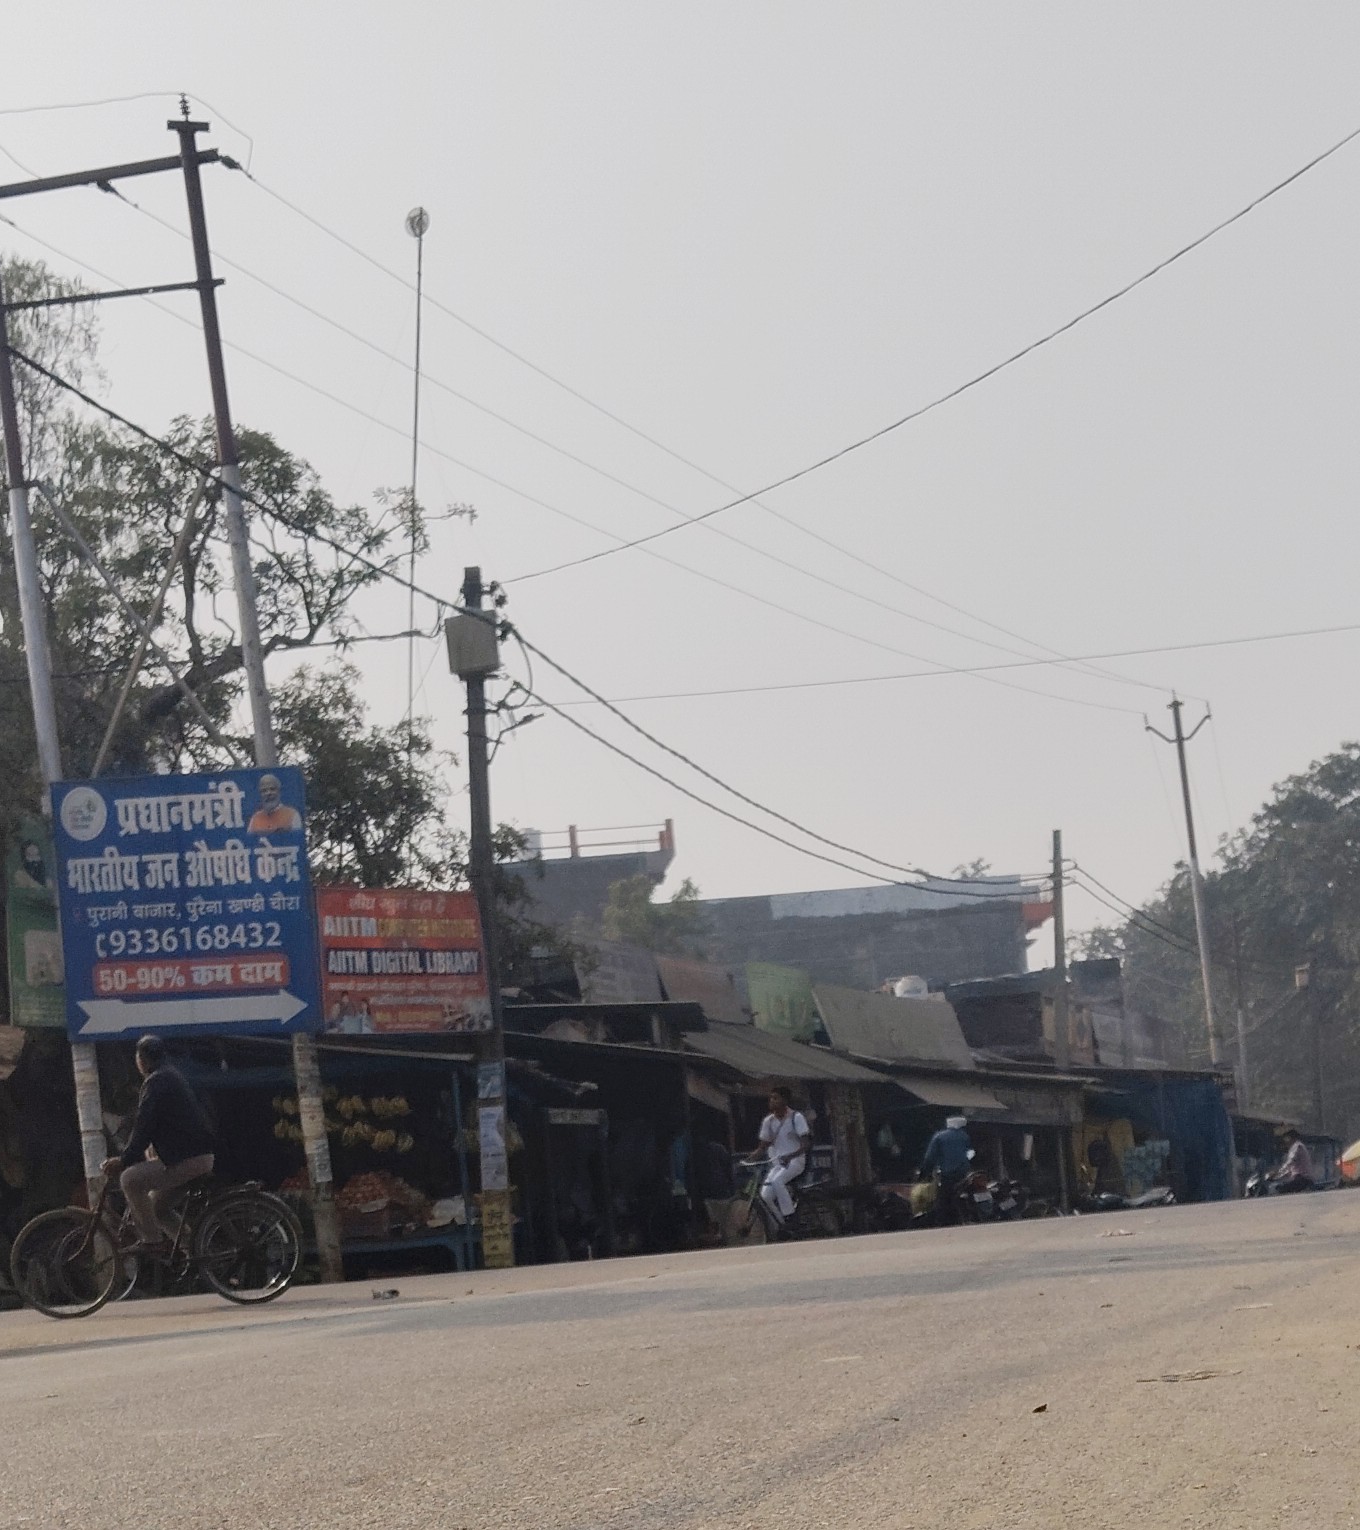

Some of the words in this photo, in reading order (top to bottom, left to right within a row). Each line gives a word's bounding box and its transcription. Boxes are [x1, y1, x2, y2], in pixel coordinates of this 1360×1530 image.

[114, 780, 246, 837] प्रधानमंत्री
[67, 845, 140, 894] भारतीय
[142, 852, 180, 889] जन
[185, 838, 253, 889] औषधि
[254, 836, 301, 883] केन्द्र
[87, 901, 128, 928] पुरानी
[132, 903, 181, 920] बाजार,
[323, 915, 377, 938] AIITM
[108, 921, 282, 955] 9336168432
[99, 965, 186, 992] 50-90%
[190, 963, 234, 986] कम
[239, 961, 284, 983] दाम
[328, 950, 369, 973] AIITM
[371, 950, 424, 974] DIGITAL
[425, 950, 479, 974] LIBRARY
